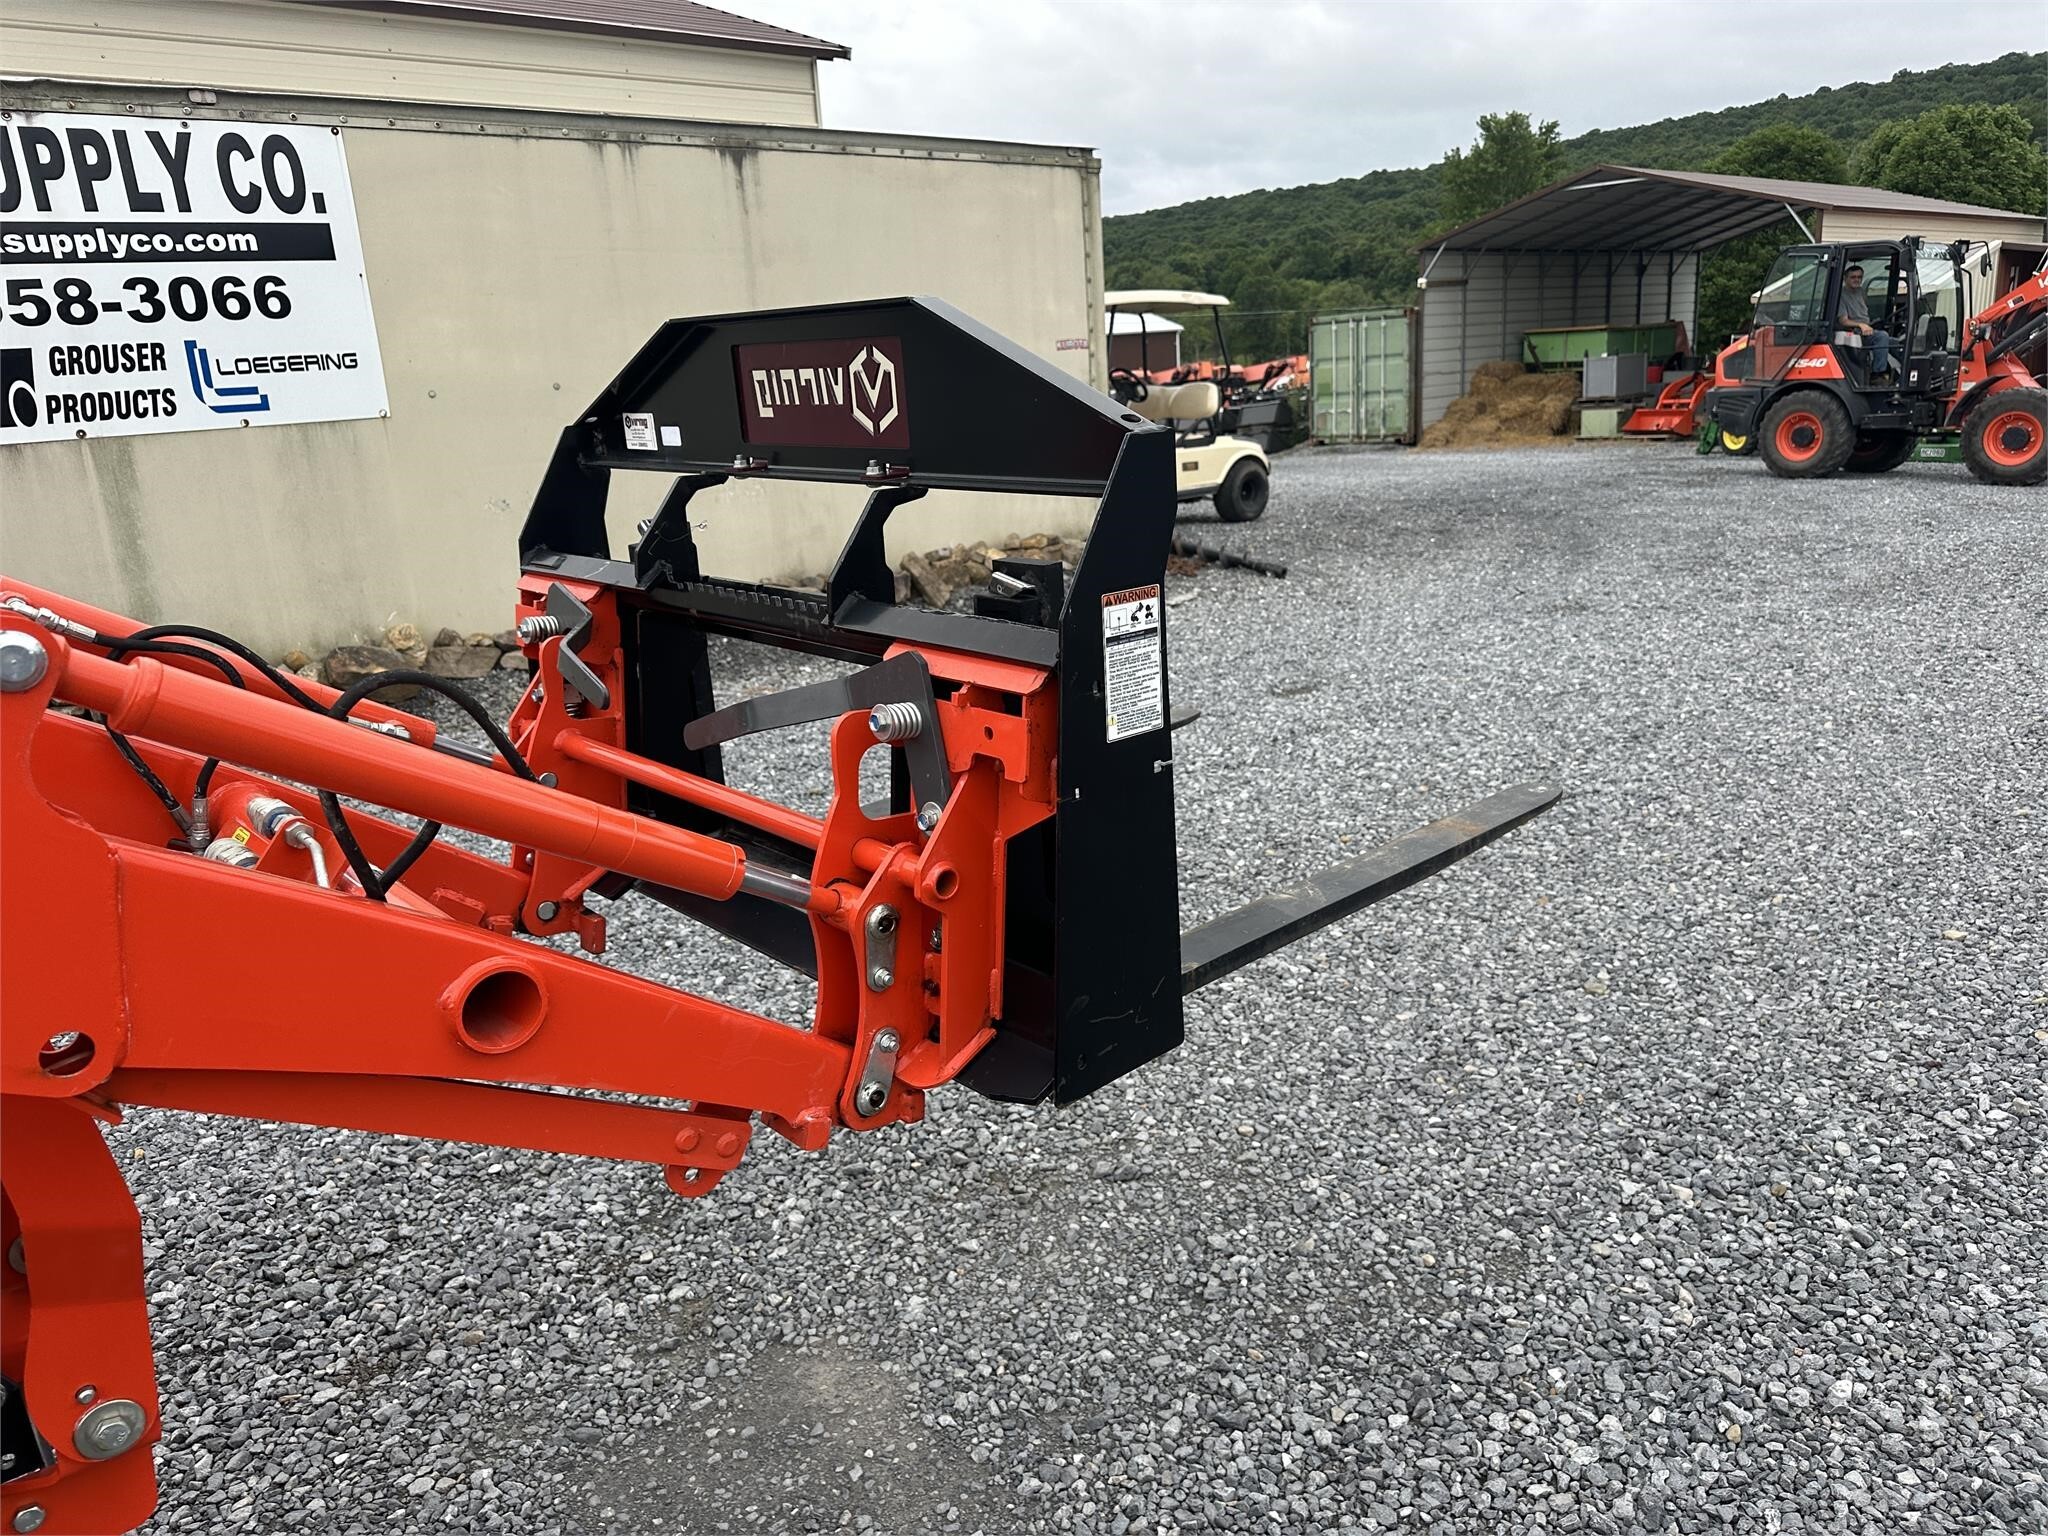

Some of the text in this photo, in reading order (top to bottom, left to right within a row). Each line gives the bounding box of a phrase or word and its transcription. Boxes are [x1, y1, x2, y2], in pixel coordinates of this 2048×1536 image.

[216, 132, 327, 215] CO.
[0, 228, 259, 259] supplyco.com
[0, 276, 292, 327] 58-3066
[49, 342, 168, 376] GROUSER
[216, 352, 359, 376] LOEGERING
[46, 388, 178, 425] PRODUCTS
[1113, 588, 1157, 606] WARNING
